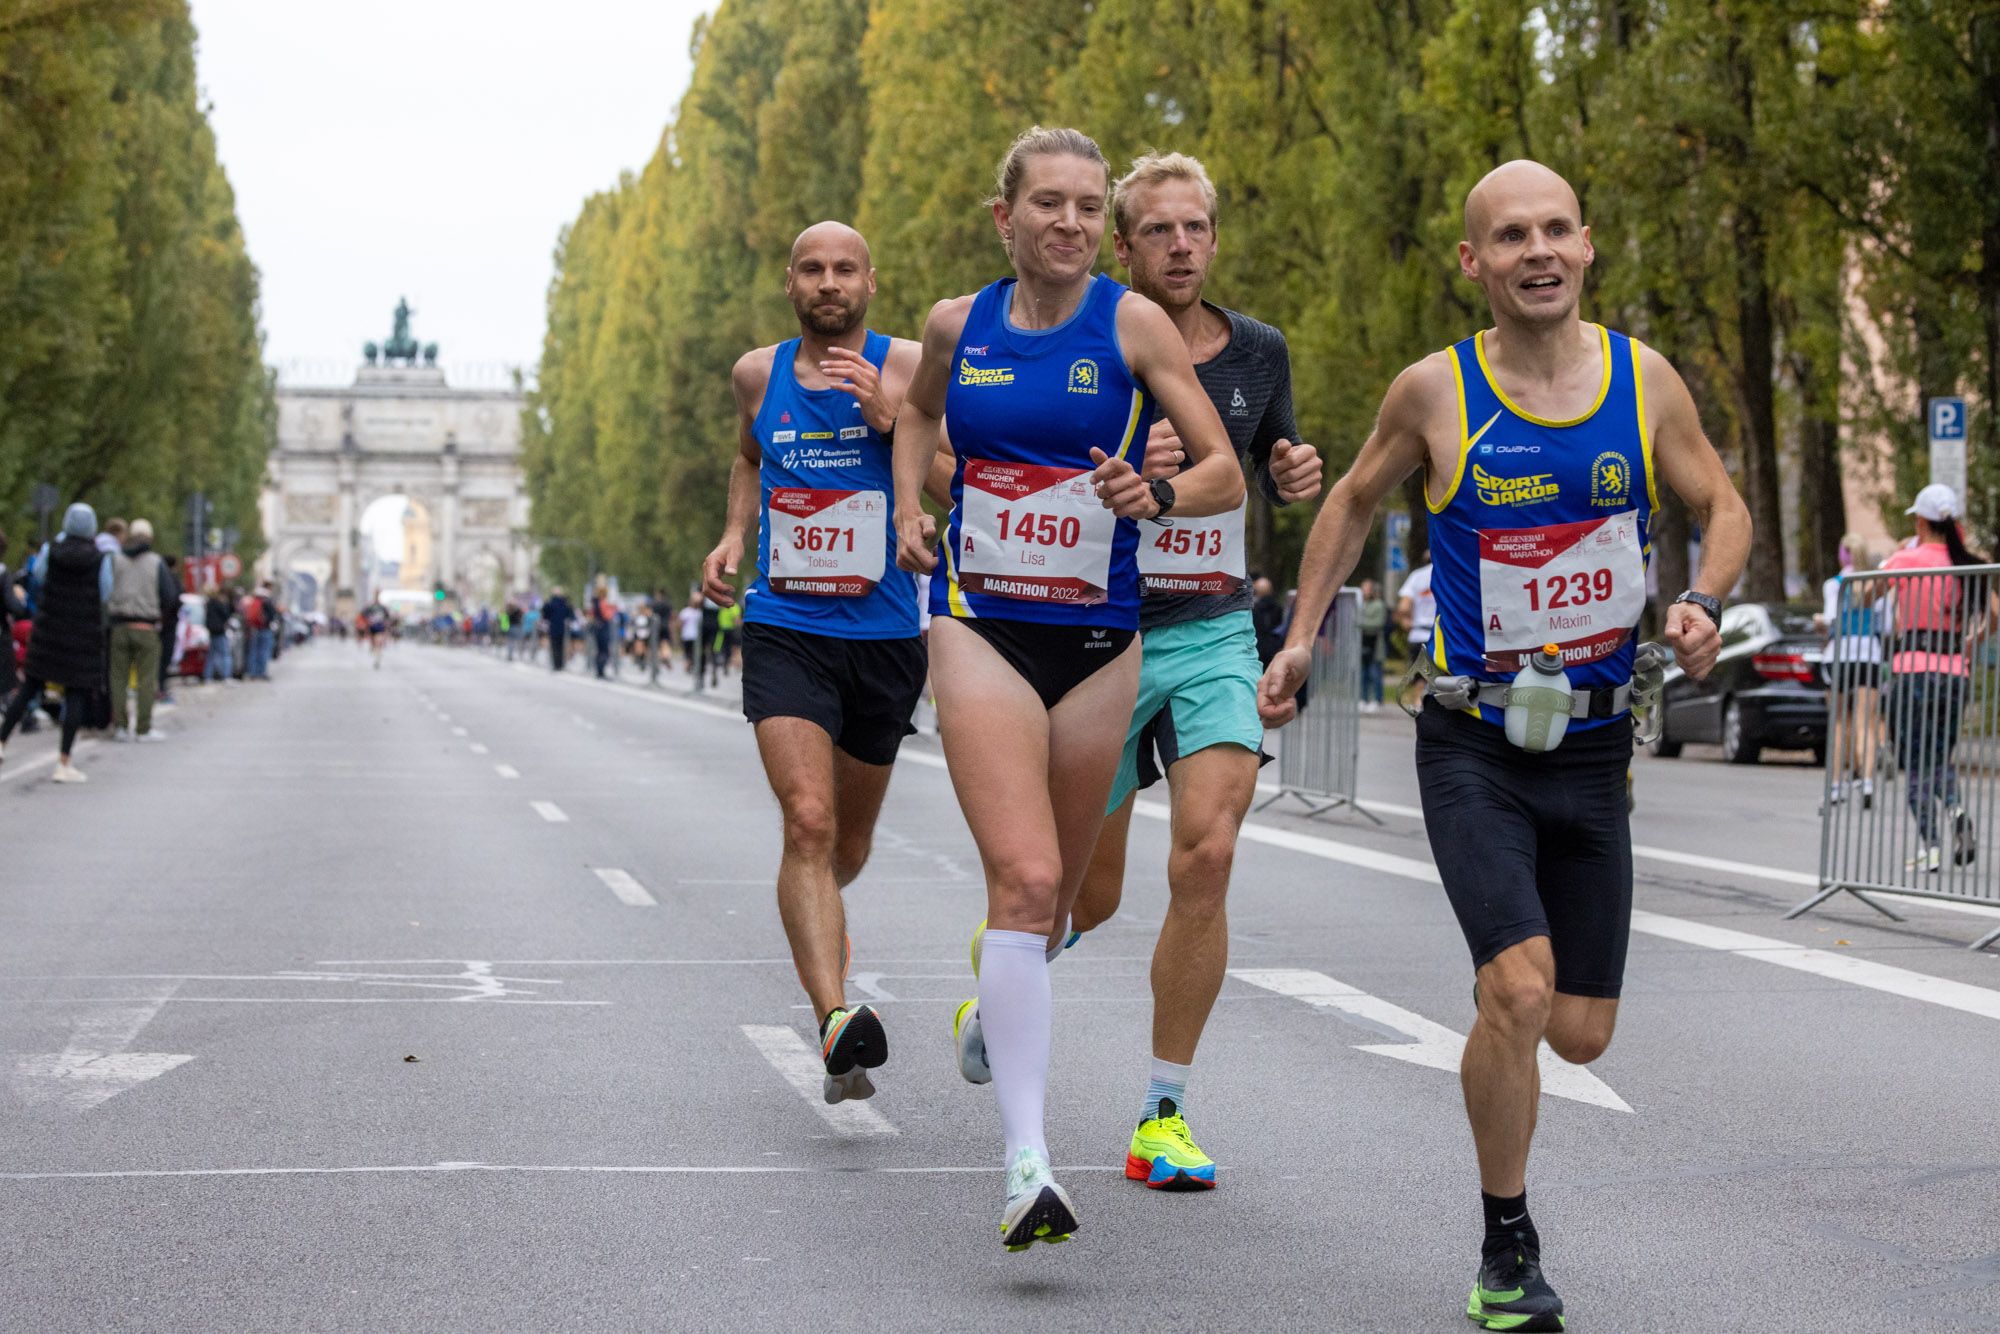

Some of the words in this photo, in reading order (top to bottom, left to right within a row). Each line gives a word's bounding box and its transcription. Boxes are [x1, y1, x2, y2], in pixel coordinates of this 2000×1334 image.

[961, 358, 1012, 376] SPORT
[959, 374, 1015, 385] JAKOB
[1067, 386, 1098, 395] PASSAU
[1935, 404, 1957, 436] P
[840, 428, 862, 439] gmg
[800, 448, 822, 457] LAV
[823, 449, 860, 457] Stadtwerke
[801, 457, 862, 469] TÜBINGEN
[977, 472, 1014, 483] MÜNCHEN
[992, 467, 1024, 477] GENERALI
[1473, 463, 1553, 490] SPORT
[990, 481, 1030, 492] MARATHON
[1477, 483, 1560, 506] JAKOB
[1591, 497, 1627, 507] PASSAU
[996, 509, 1081, 549] 1450
[793, 525, 854, 552] 3671
[964, 536, 975, 553] A
[1154, 528, 1222, 556] 4513
[1509, 533, 1545, 543] GENERALI
[1492, 543, 1537, 551] MÜNCHEN
[1509, 548, 1554, 559] MARATHON
[772, 548, 780, 562] A
[807, 555, 839, 568] Tobias
[1020, 550, 1046, 566] Lisa
[785, 579, 836, 593] MARATHON
[838, 583, 862, 594] 2022
[983, 577, 1048, 597] MARATHON
[1051, 586, 1079, 600] 2022
[1145, 576, 1200, 591] MARATHON
[1201, 580, 1222, 591] 2022
[1523, 568, 1613, 612] 1239
[1489, 614, 1503, 631] A
[1549, 613, 1592, 631] Maxim
[1084, 641, 1112, 649] erima
[1518, 645, 1592, 667] MTHON
[1594, 637, 1619, 656] 2022
